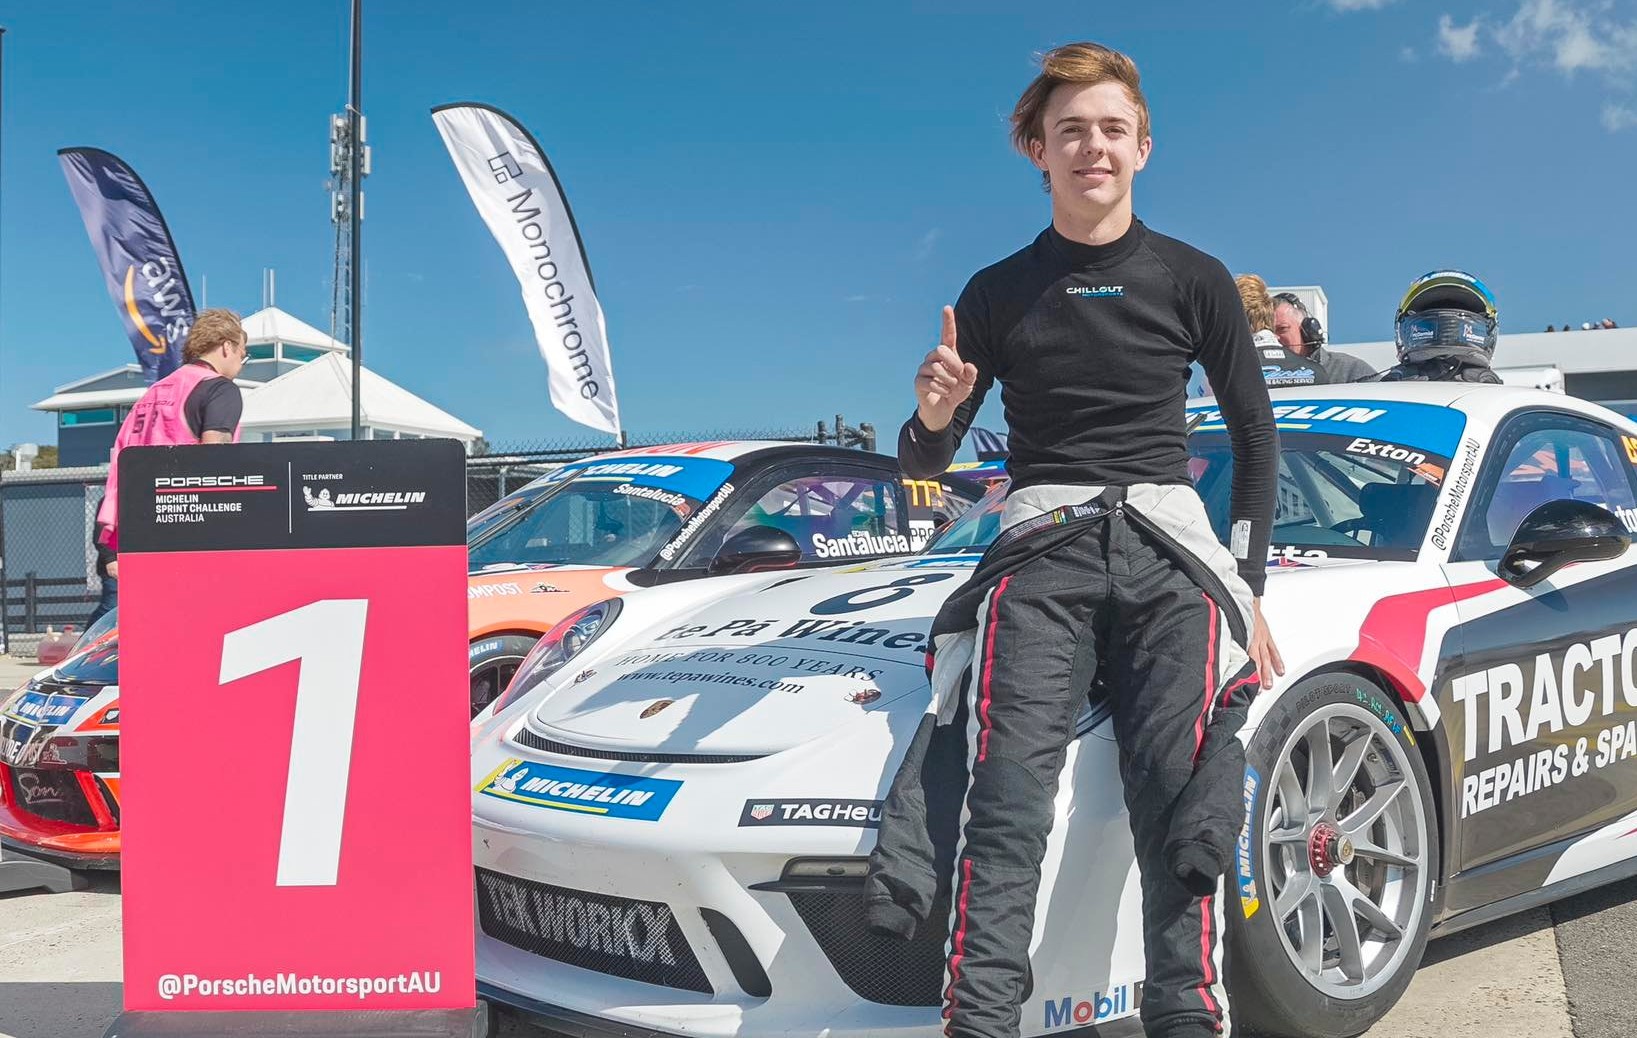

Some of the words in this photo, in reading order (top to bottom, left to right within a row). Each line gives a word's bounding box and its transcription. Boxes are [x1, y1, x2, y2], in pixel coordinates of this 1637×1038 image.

[142, 256, 190, 344] aws
[506, 188, 600, 401] Monochrome
[1065, 285, 1124, 294] CHILLOUT
[1346, 438, 1427, 466] Exton
[155, 475, 264, 488] PORSCHE
[553, 464, 684, 480] CHELIN
[155, 494, 199, 504] MICHELIN
[335, 491, 426, 505] MICHELIN
[613, 483, 686, 506] Santalucia
[902, 478, 944, 508] 777
[1431, 438, 1480, 551] @PorscheMotorsportAU
[155, 504, 189, 514] SPRINT
[190, 502, 242, 513] CHALLENGE
[155, 513, 205, 523] AUSTRALIA
[659, 483, 735, 561] @PorscheMotorsportAU
[811, 530, 910, 558] Santalucia
[654, 623, 707, 641] te
[614, 651, 684, 667] HOME
[681, 652, 731, 665] FOR
[736, 654, 790, 668] 800
[791, 656, 885, 682] YEARS
[617, 671, 805, 695] www.tepawines.com
[1451, 628, 1637, 762] TRACTO
[218, 598, 369, 887] 1
[1461, 743, 1569, 819] REPAIRS
[1571, 736, 1589, 777] &
[1595, 720, 1637, 768] SPA
[520, 776, 656, 807] MICHELIN
[780, 803, 883, 821] TAGHeu
[1239, 774, 1257, 879] MICHELIN
[157, 971, 441, 1000] @PorscheMotorsportAU
[1044, 985, 1127, 1029] Mobil
